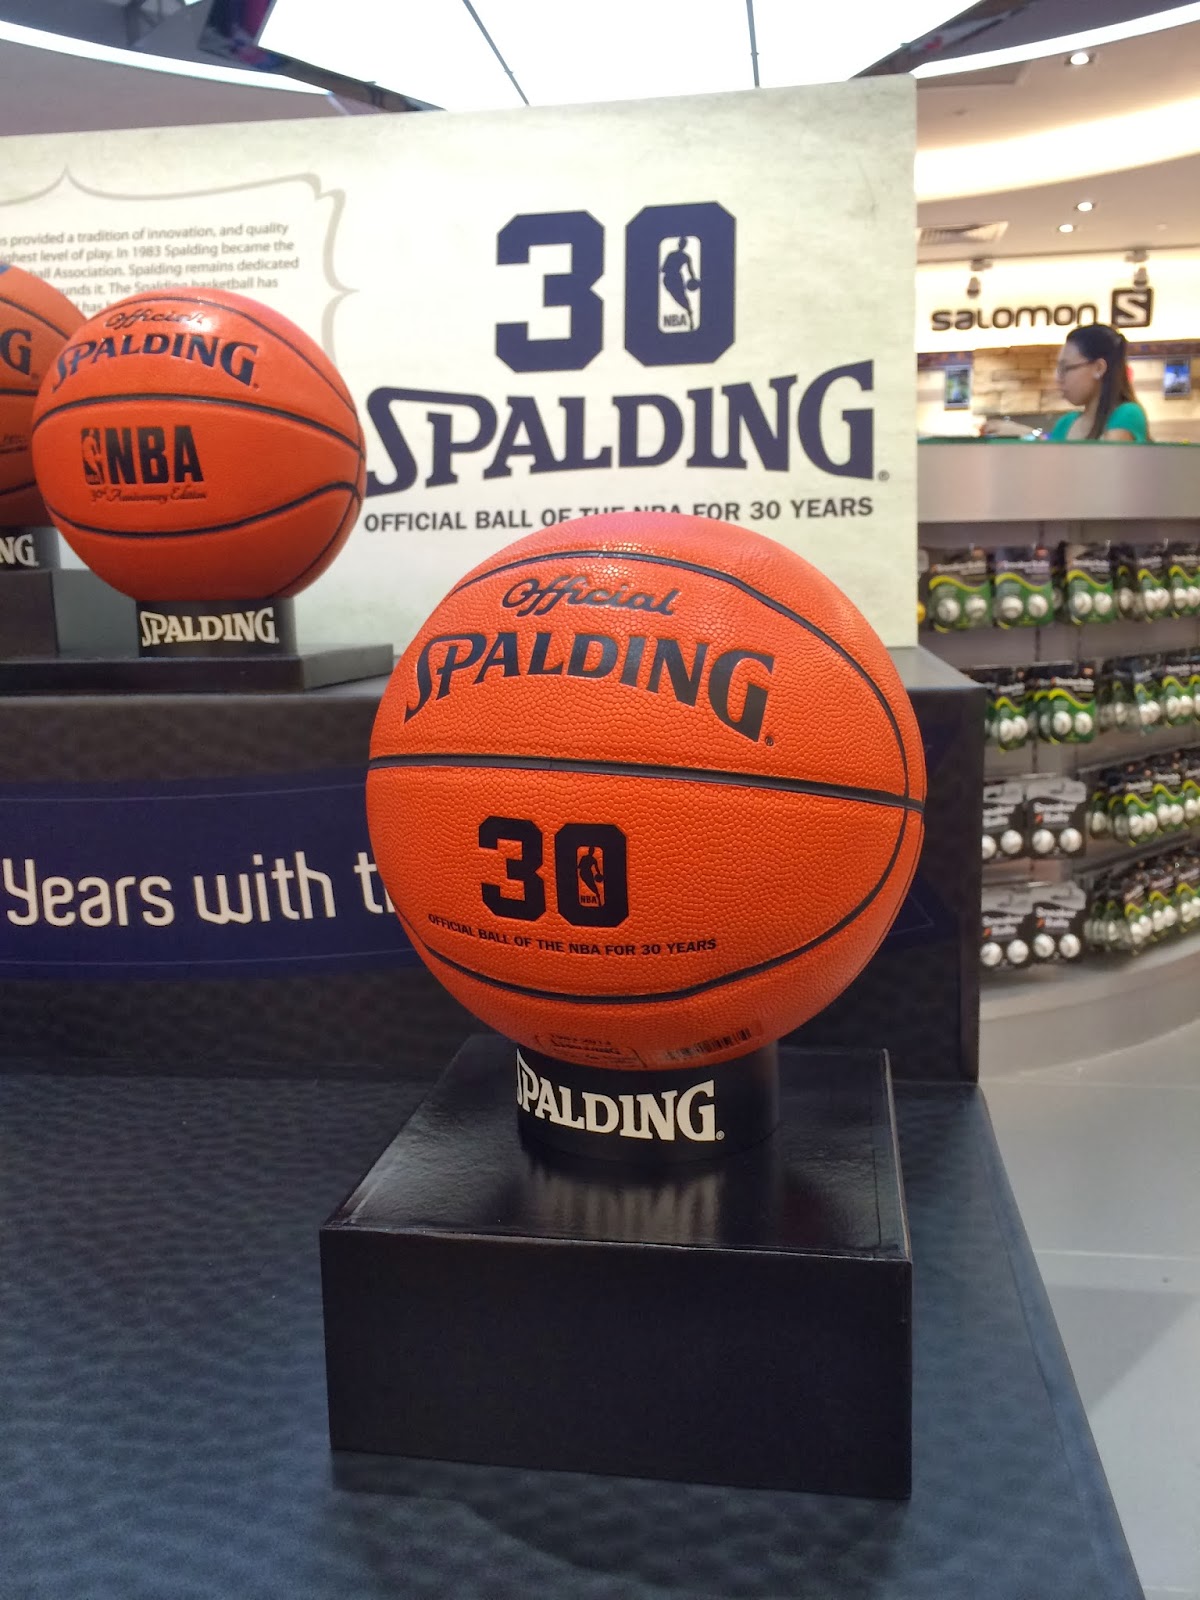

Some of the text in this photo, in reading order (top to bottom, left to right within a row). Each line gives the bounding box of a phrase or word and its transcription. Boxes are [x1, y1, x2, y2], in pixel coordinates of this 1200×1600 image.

[10, 231, 64, 247] provided
[67, 234, 74, 242] a
[77, 229, 129, 241] tradition
[132, 227, 146, 240] of
[148, 226, 217, 239] innovation,
[220, 223, 243, 236] and
[246, 222, 289, 236] quality
[41, 249, 68, 261] level
[71, 247, 84, 260] of
[86, 248, 112, 262] play.
[117, 247, 128, 258] In
[133, 245, 161, 258] 1983
[165, 244, 218, 258] Spalding
[222, 241, 270, 254] became
[273, 239, 294, 251] the
[54, 266, 125, 278] Association.
[129, 263, 182, 276] Spalding
[185, 262, 234, 274] remains
[237, 257, 299, 270] dedicated
[110, 282, 130, 293] The
[191, 277, 253, 289] basketball
[257, 277, 278, 288] has
[495, 201, 736, 373] 30
[663, 314, 687, 328] NBA
[931, 303, 1097, 330] salomon
[51, 333, 259, 392] SPALDING
[366, 359, 873, 498] SPALDING
[104, 425, 204, 485] NBA
[364, 512, 467, 533] OFFICIAL
[476, 510, 532, 529] BALL
[541, 508, 572, 526] OF
[694, 503, 740, 520] FOR
[750, 500, 781, 519] 30
[791, 497, 873, 518] YEARS
[502, 574, 681, 618] Official
[140, 607, 276, 647] SPALDING
[404, 632, 774, 742] SPALDING
[2, 858, 175, 927] Years
[193, 851, 337, 925] with
[479, 815, 629, 928] 30
[428, 914, 717, 955] OFFICIAL BALL OF THE NBA FOR 30 YEARS
